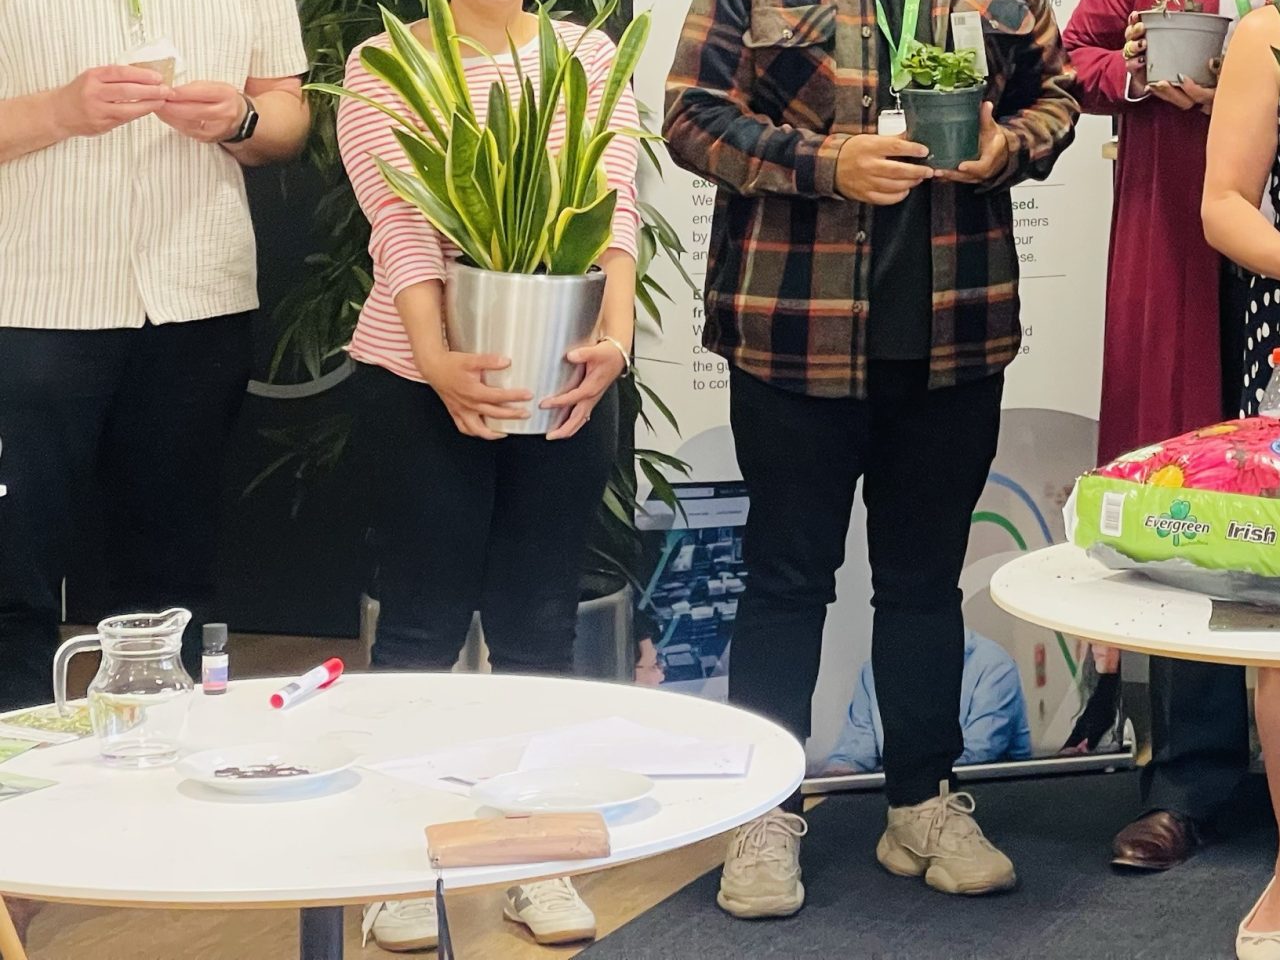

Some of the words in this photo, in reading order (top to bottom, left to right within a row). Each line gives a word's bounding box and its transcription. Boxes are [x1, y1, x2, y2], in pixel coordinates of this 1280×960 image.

[692, 194, 713, 207] We
[692, 230, 708, 244] by
[693, 360, 713, 372] the
[693, 378, 705, 390] to
[1145, 515, 1211, 534] Evergreen
[1227, 521, 1277, 544] Irish
